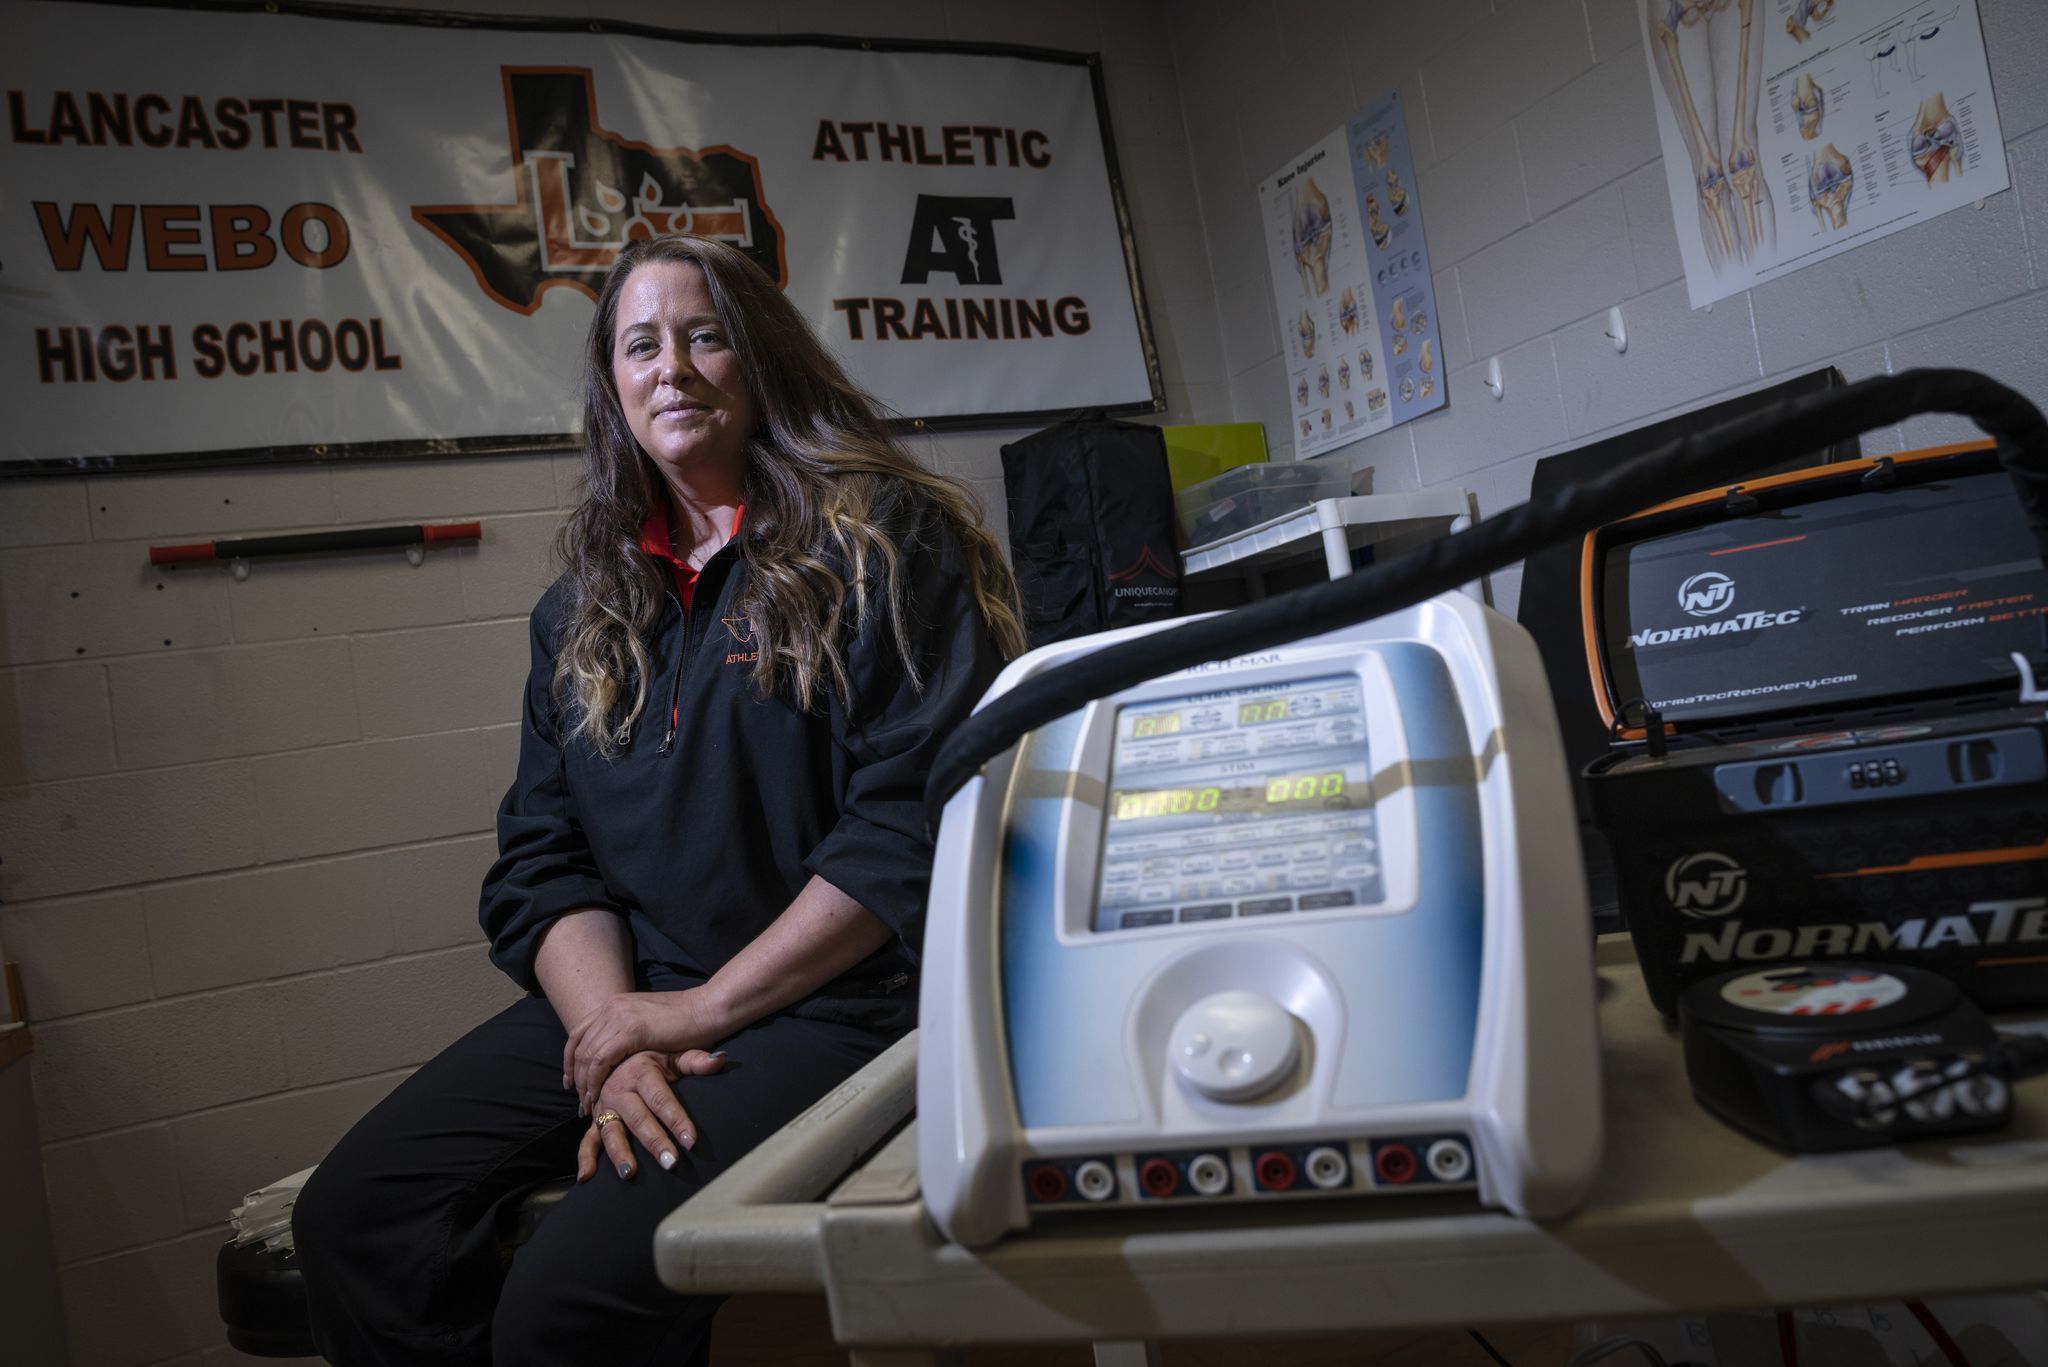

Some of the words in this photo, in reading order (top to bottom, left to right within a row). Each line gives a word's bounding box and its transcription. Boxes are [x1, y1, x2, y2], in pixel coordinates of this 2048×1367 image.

[8, 90, 363, 153] LANCASTER
[812, 120, 1051, 169] ATHLETIC
[32, 200, 350, 272] WEBO
[901, 193, 1015, 286] AT
[834, 297, 1091, 340] TRAINING
[35, 325, 178, 383] HIGH
[192, 318, 402, 379] SCHOOL
[1114, 585, 1178, 598] UNIQUECANOP
[1839, 601, 1890, 615] TRAIN
[1893, 588, 1969, 607] HARDER
[1866, 606, 1953, 626] RECOVER
[1957, 593, 2033, 612] FASTER
[1895, 616, 1985, 636] PERFORM
[1640, 674, 1857, 710] ormaTecRecovery.com
